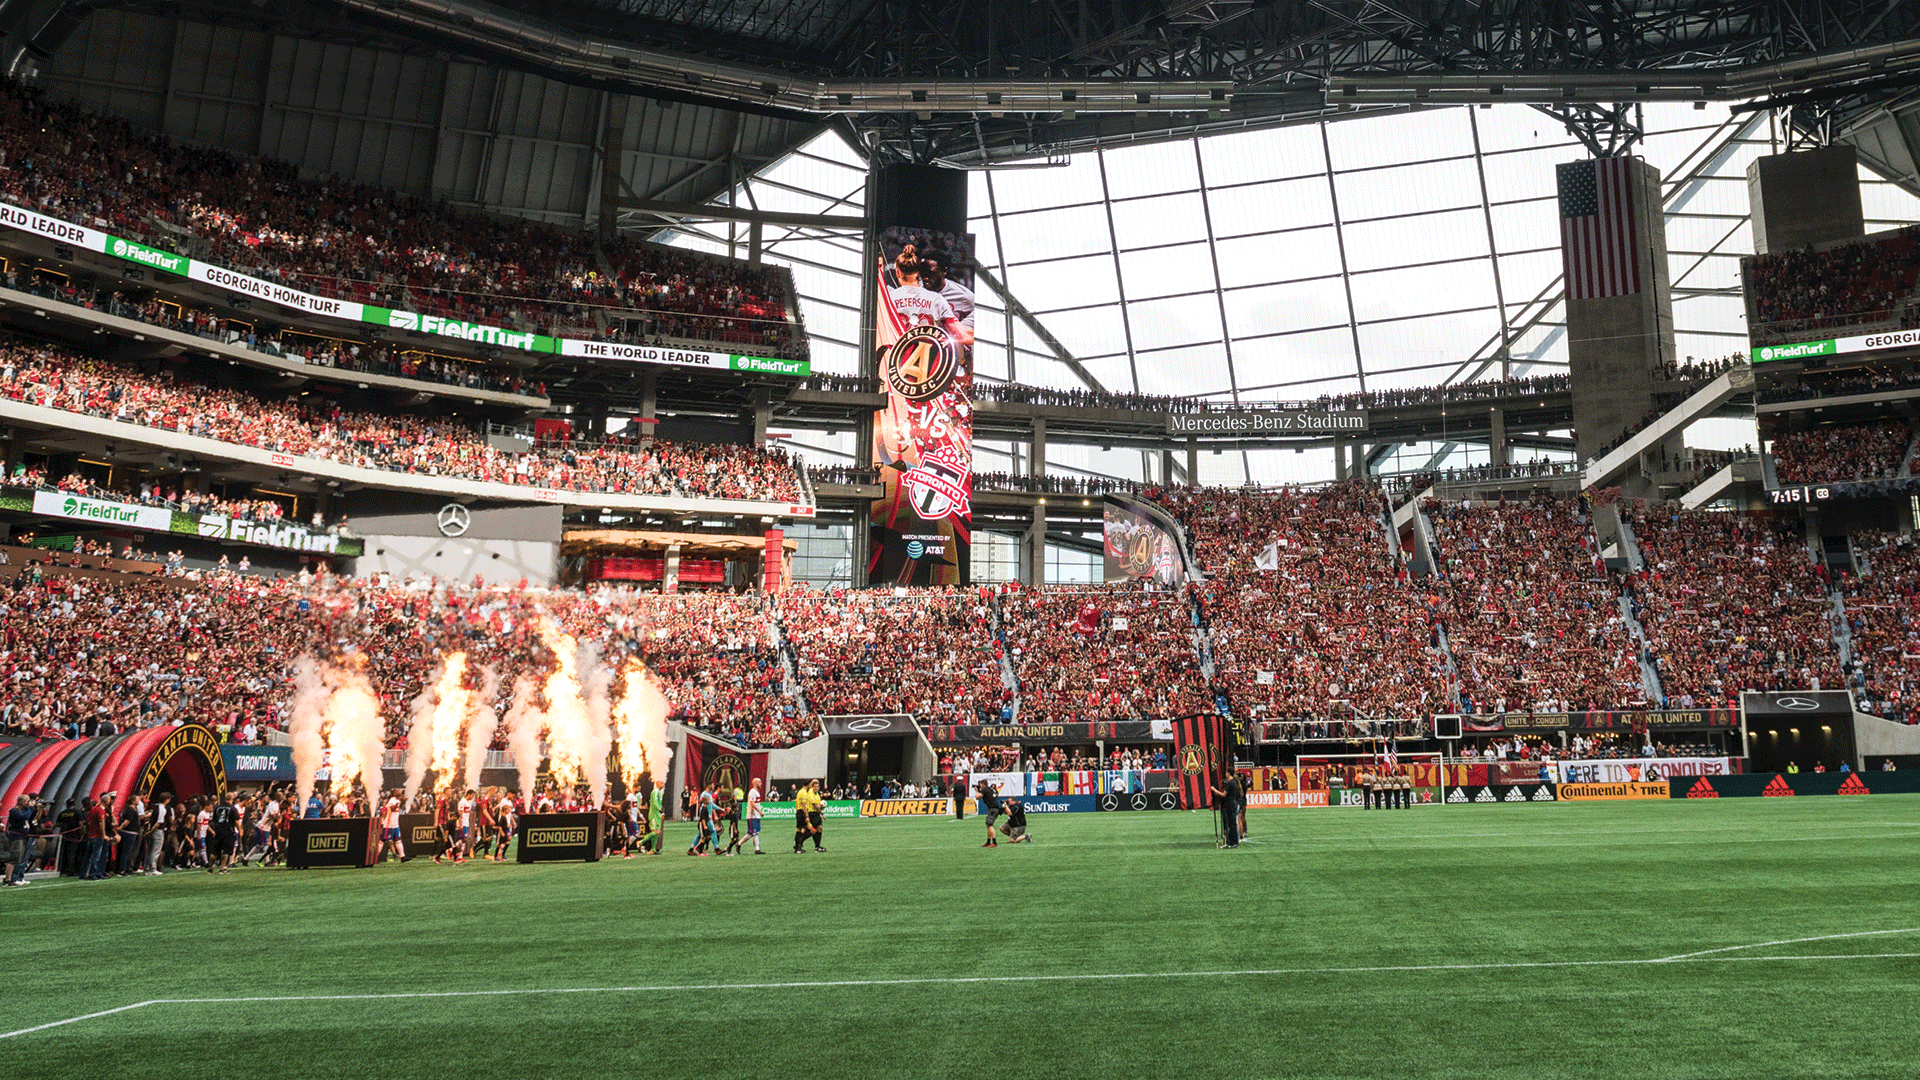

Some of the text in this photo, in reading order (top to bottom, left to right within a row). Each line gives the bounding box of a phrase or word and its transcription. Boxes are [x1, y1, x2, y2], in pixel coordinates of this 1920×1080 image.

[0, 207, 85, 244] RLD LEADER
[127, 244, 178, 271] FieldTurf
[206, 268, 341, 314] GEORGIA'S HOME TURF
[894, 297, 932, 309] PETERSON
[421, 315, 534, 351] FieldTurf
[906, 325, 949, 350] ATLANTA
[583, 343, 710, 365] THE WORLD LEADER
[1773, 342, 1824, 359] FieldTurf
[751, 358, 800, 374] FieldTurf
[888, 365, 937, 396] UNITED FC
[919, 405, 950, 439] VS
[1171, 413, 1364, 431] Mercedes-Benz Stadium
[912, 470, 961, 502] TORONTO
[1771, 489, 1801, 504] 7:15
[79, 501, 139, 523] FieldTurf
[229, 518, 340, 554] FieldTurf
[925, 546, 946, 555] AT&T
[1507, 717, 1527, 725] UNITE
[1535, 715, 1568, 725] CONQUER
[1621, 711, 1702, 724] ATNTA UNITED
[981, 725, 1064, 738] ATLANTA UNITED
[147, 729, 225, 794] ATLANTA UNITED FC
[236, 755, 278, 771] TORONTO FC
[711, 756, 741, 771] ATLANTA
[1565, 764, 1599, 782] ERE
[1604, 764, 1623, 782] TO
[1504, 794, 1526, 802] adidas
[1532, 793, 1554, 801] adidas
[1561, 784, 1666, 799] Continental TIRE
[1686, 790, 1719, 798] adidas
[1762, 788, 1795, 797] adidas
[1838, 786, 1870, 795] adidas
[1246, 793, 1281, 805] HOME
[1447, 795, 1469, 803] adidas
[1475, 795, 1497, 803] adidas
[821, 805, 854, 813] hildren's
[861, 799, 947, 817] QUIKRETE
[416, 829, 437, 840] UNIT
[530, 831, 585, 844] CONQUER
[311, 836, 345, 849] UNITE
